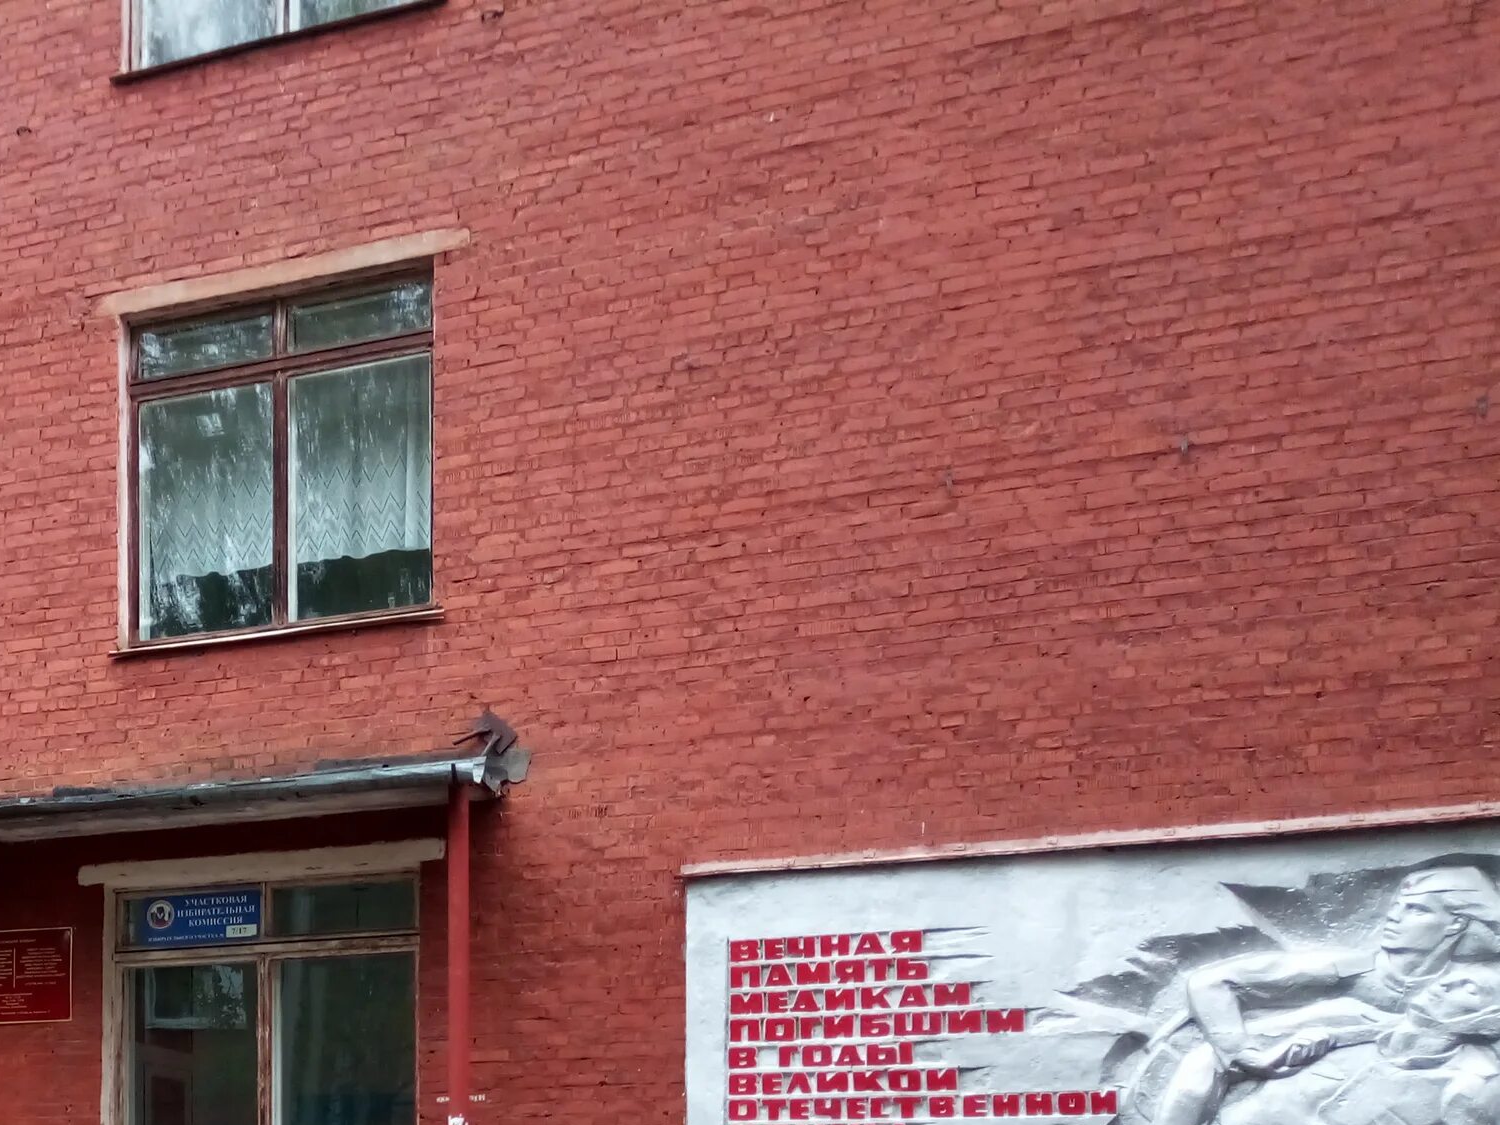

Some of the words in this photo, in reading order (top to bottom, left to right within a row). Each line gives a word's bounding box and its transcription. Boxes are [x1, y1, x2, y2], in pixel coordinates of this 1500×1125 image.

[177, 905, 256, 918] ИЗБИРАТЕЛЬНАЯ
[185, 895, 248, 907] УЧАСТКОВАЯ
[188, 916, 243, 928] КОМИССИЯ
[729, 931, 923, 963] ВЕЧНАЯ
[729, 958, 929, 988] ПАМЯТЬ
[729, 983, 971, 1015] МЕДИКАМ
[728, 1009, 1025, 1042] ПОГИБШИМ
[727, 1046, 758, 1069] В
[778, 1042, 914, 1067] ГОДЫ
